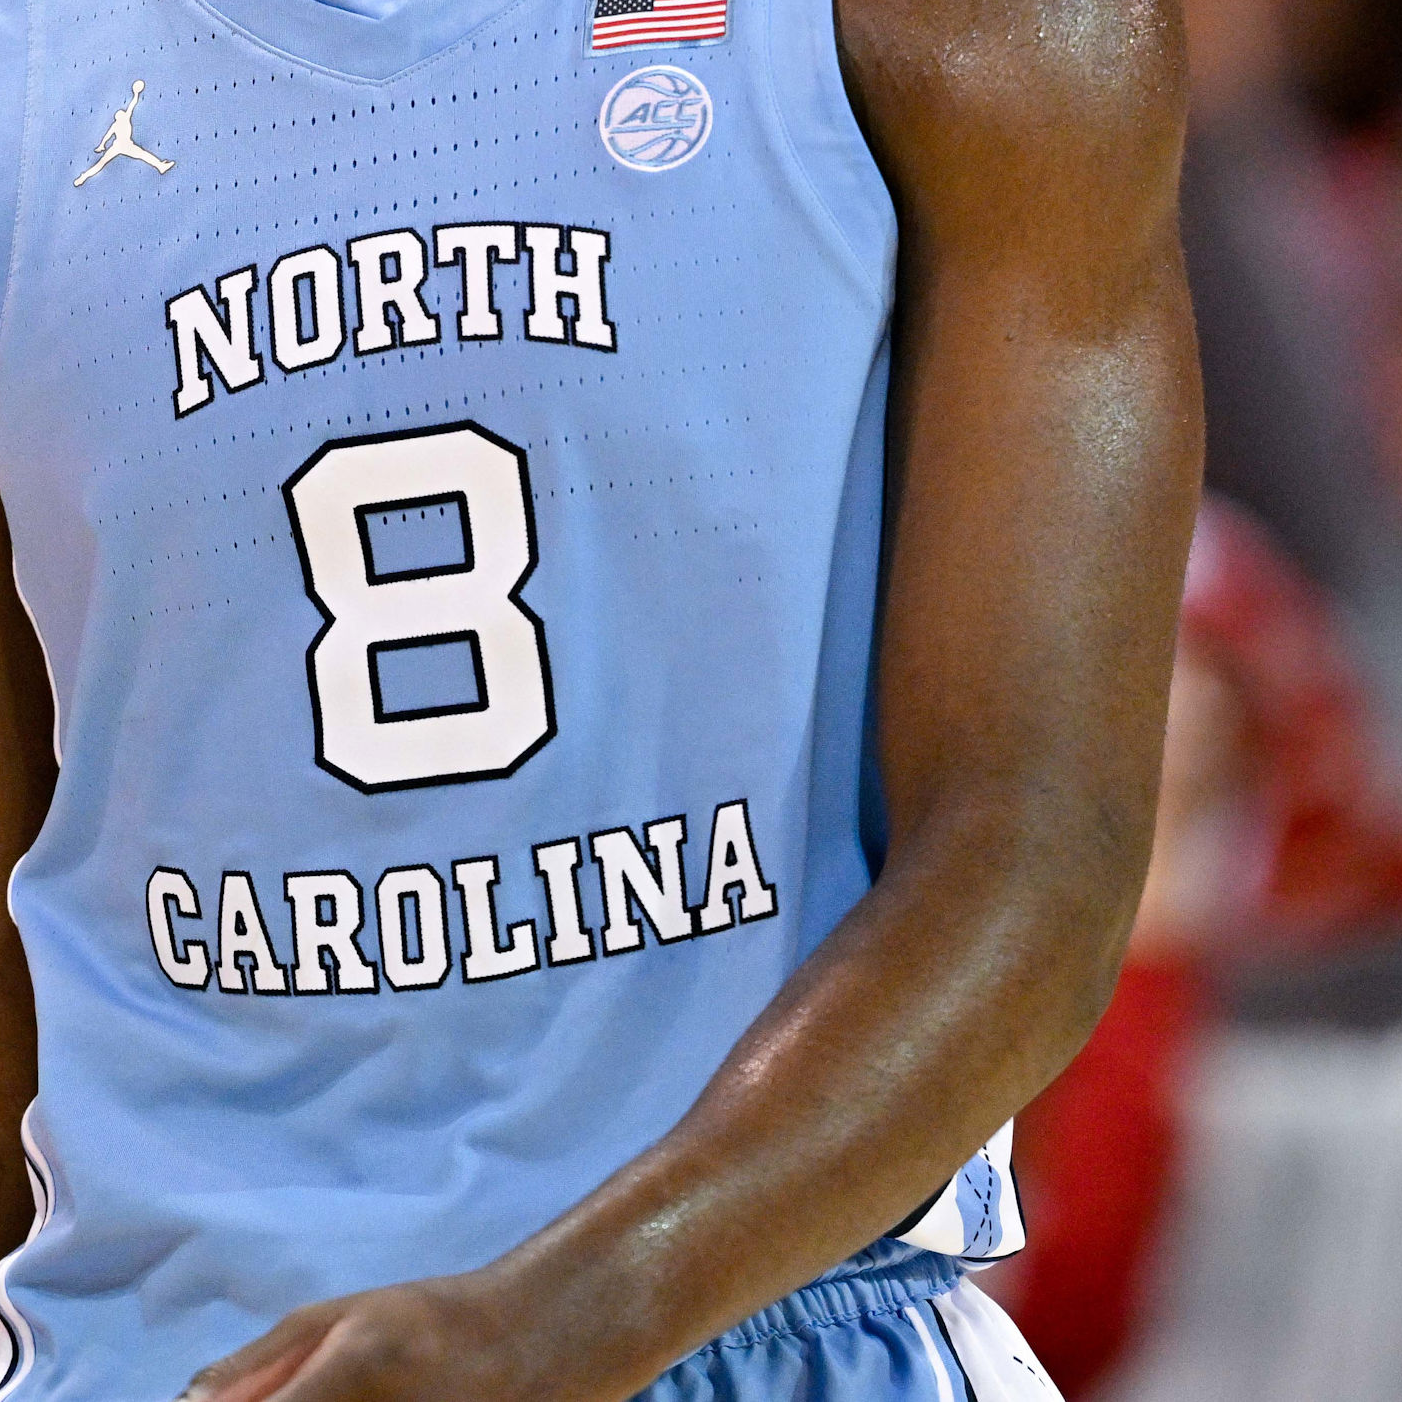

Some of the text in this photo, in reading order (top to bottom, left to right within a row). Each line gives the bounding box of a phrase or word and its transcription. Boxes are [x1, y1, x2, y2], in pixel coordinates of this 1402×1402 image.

[619, 97, 704, 125] ACC
[165, 220, 618, 419] NORTH
[282, 419, 558, 795] 8
[145, 798, 780, 995] CAROLINA
